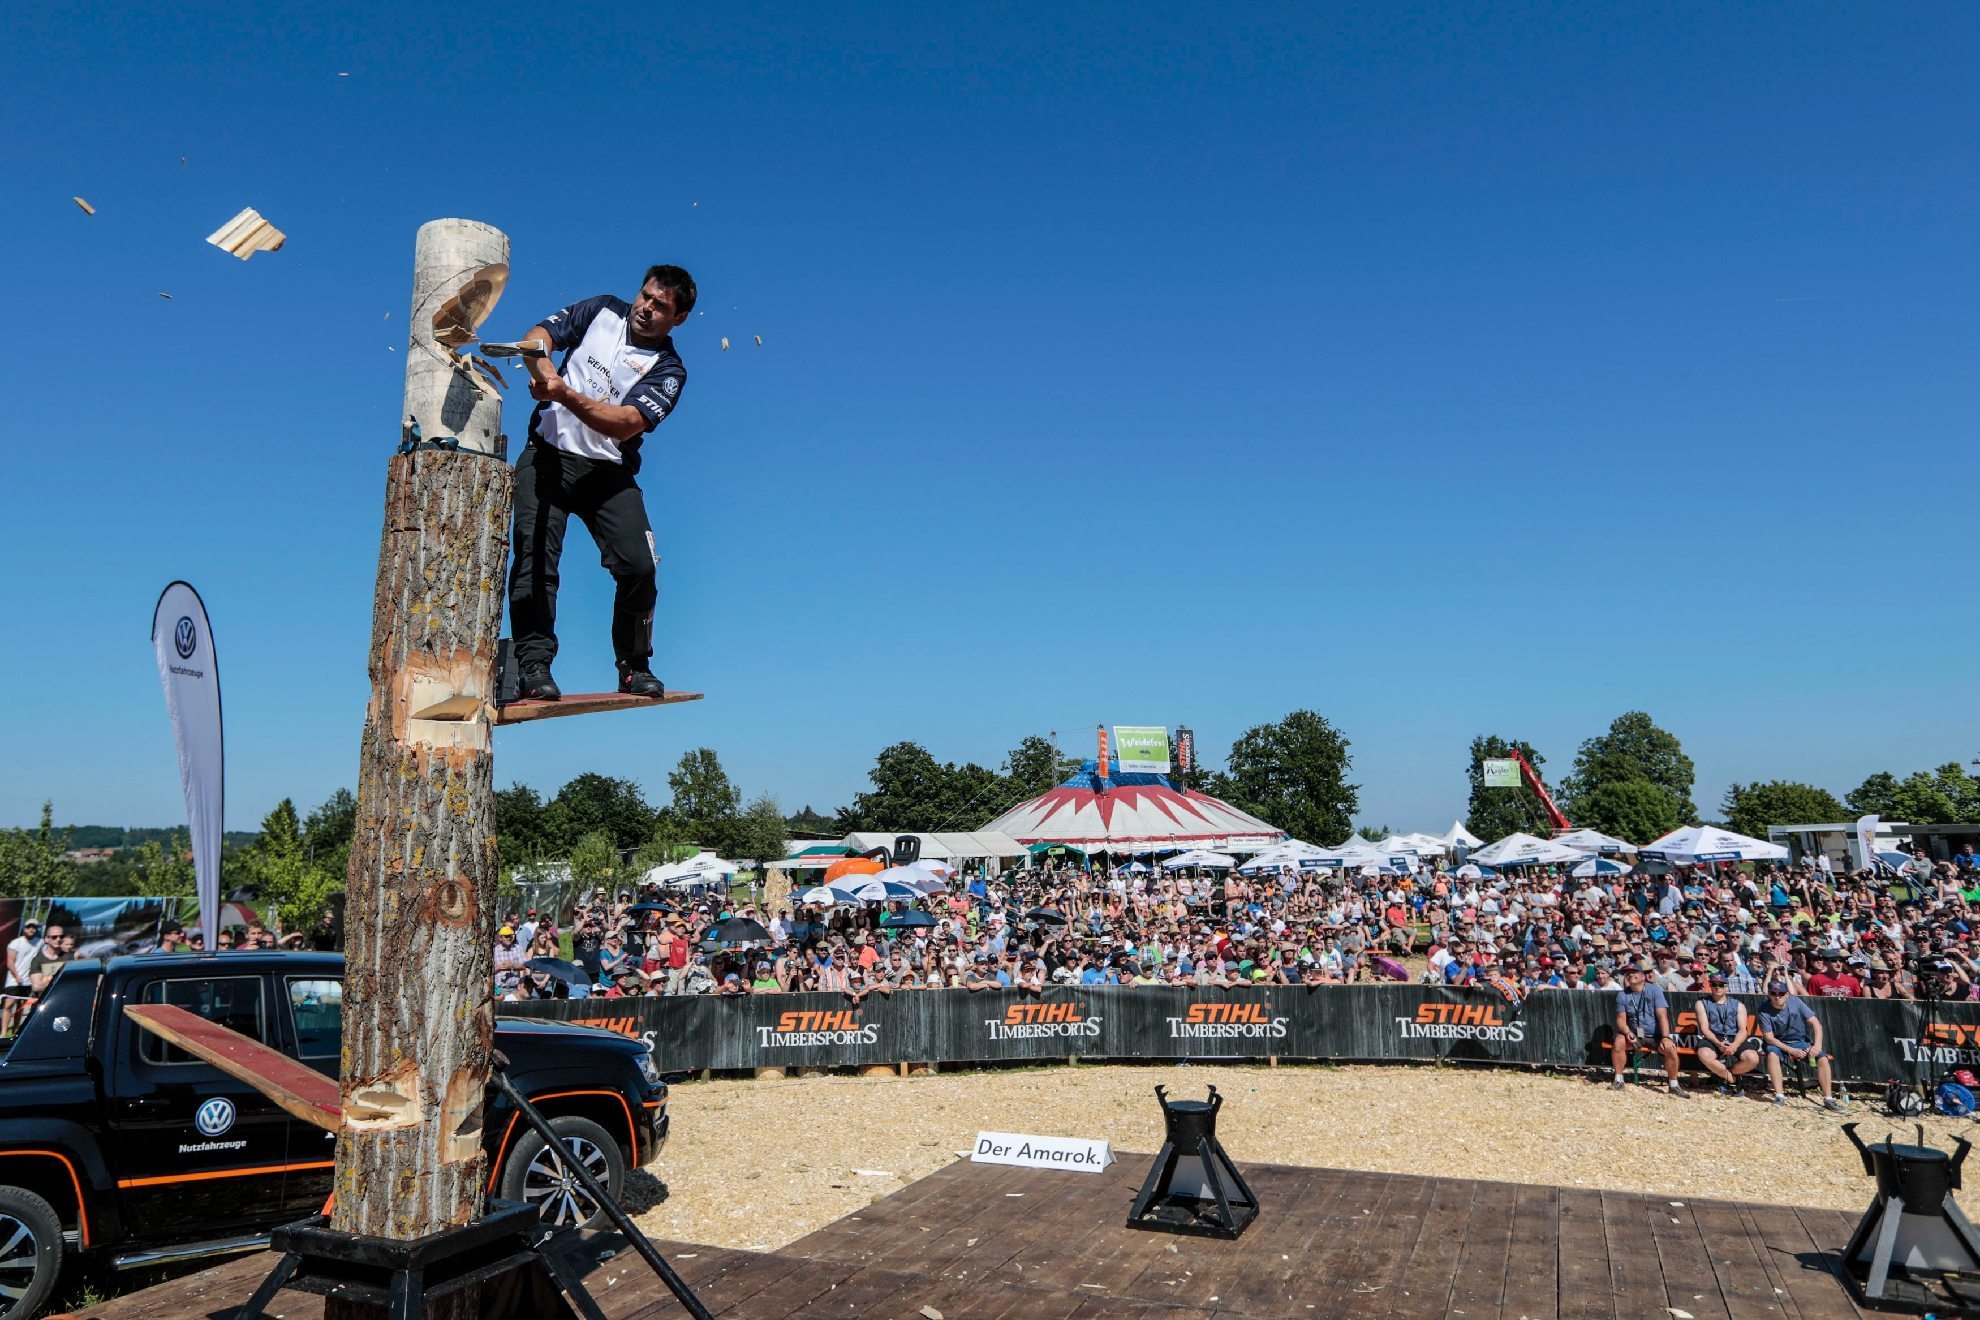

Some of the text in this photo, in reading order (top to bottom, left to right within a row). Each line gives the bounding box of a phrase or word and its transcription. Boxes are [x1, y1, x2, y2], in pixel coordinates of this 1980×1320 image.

[776, 1010, 860, 1032] STIHL
[1004, 1002, 1083, 1025] STIHL
[1186, 1003, 1268, 1023] STIHL
[1415, 1003, 1504, 1026] STIHL
[757, 1023, 878, 1048] TIMBERSPORTS
[985, 1016, 1101, 1040] TIMBERSPORTS
[1166, 1016, 1287, 1038] TIMBERSPORTS
[1395, 1016, 1524, 1042] TIMBERSPORTS
[178, 1140, 247, 1153] Nutzfahrzeuge
[977, 1139, 1101, 1165] Der Amarok.
